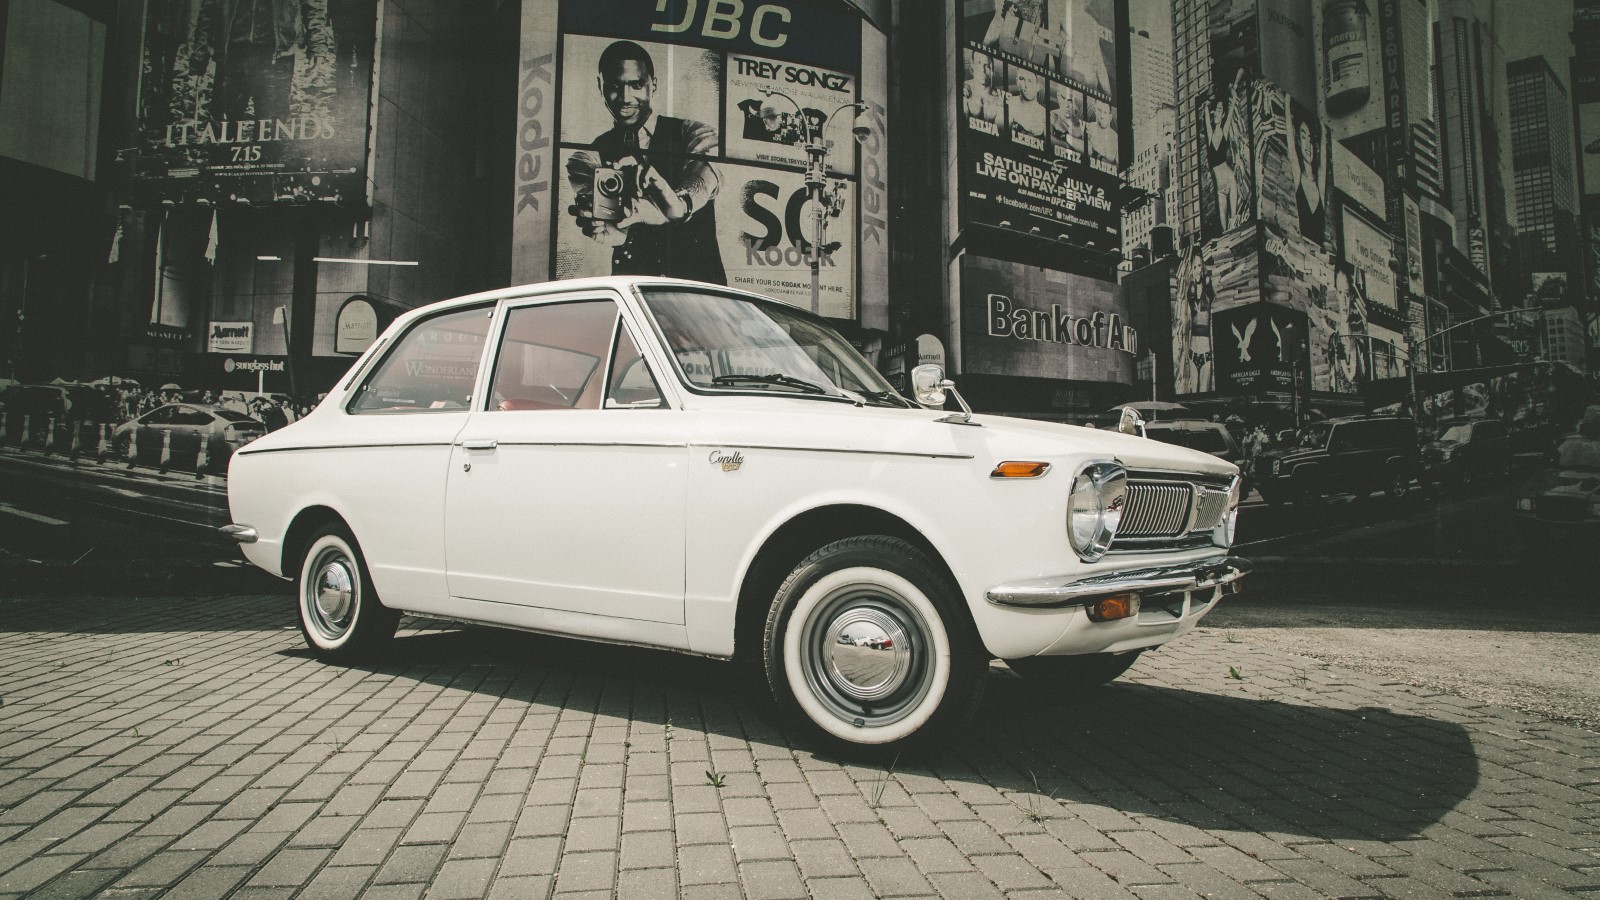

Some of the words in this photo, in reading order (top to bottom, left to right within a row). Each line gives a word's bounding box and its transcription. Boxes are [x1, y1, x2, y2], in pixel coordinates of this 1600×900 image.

[1329, 30, 1361, 45] energy
[733, 57, 782, 80] TREY
[785, 66, 850, 93] SONGZ
[1385, 26, 1401, 129] SQUARE
[164, 123, 193, 147] IT
[257, 117, 336, 142] ENDS
[517, 53, 552, 216] Kodak
[969, 116, 1000, 137] SILVA
[1011, 130, 1045, 151] LEBEN
[756, 153, 769, 162] VISIT
[1054, 144, 1082, 164] ORTIZ
[983, 152, 1059, 184] SATURDAY
[1063, 177, 1093, 195] JULY
[1096, 187, 1105, 200] 2
[976, 162, 1007, 182] LIVE
[1008, 170, 1029, 188] ON
[1031, 178, 1112, 212] PAY-PER-VIEW
[744, 238, 837, 267] Kodak
[1355, 238, 1369, 259] Two
[734, 276, 754, 285] SHARE
[755, 278, 772, 287] YOUR
[781, 280, 801, 289] KODAK
[802, 283, 827, 291] MONT
[987, 293, 1072, 345] Bank
[1073, 311, 1105, 348] of
[210, 325, 249, 339] Marriott
[235, 360, 269, 372] sunglass
[269, 360, 285, 372] hut
